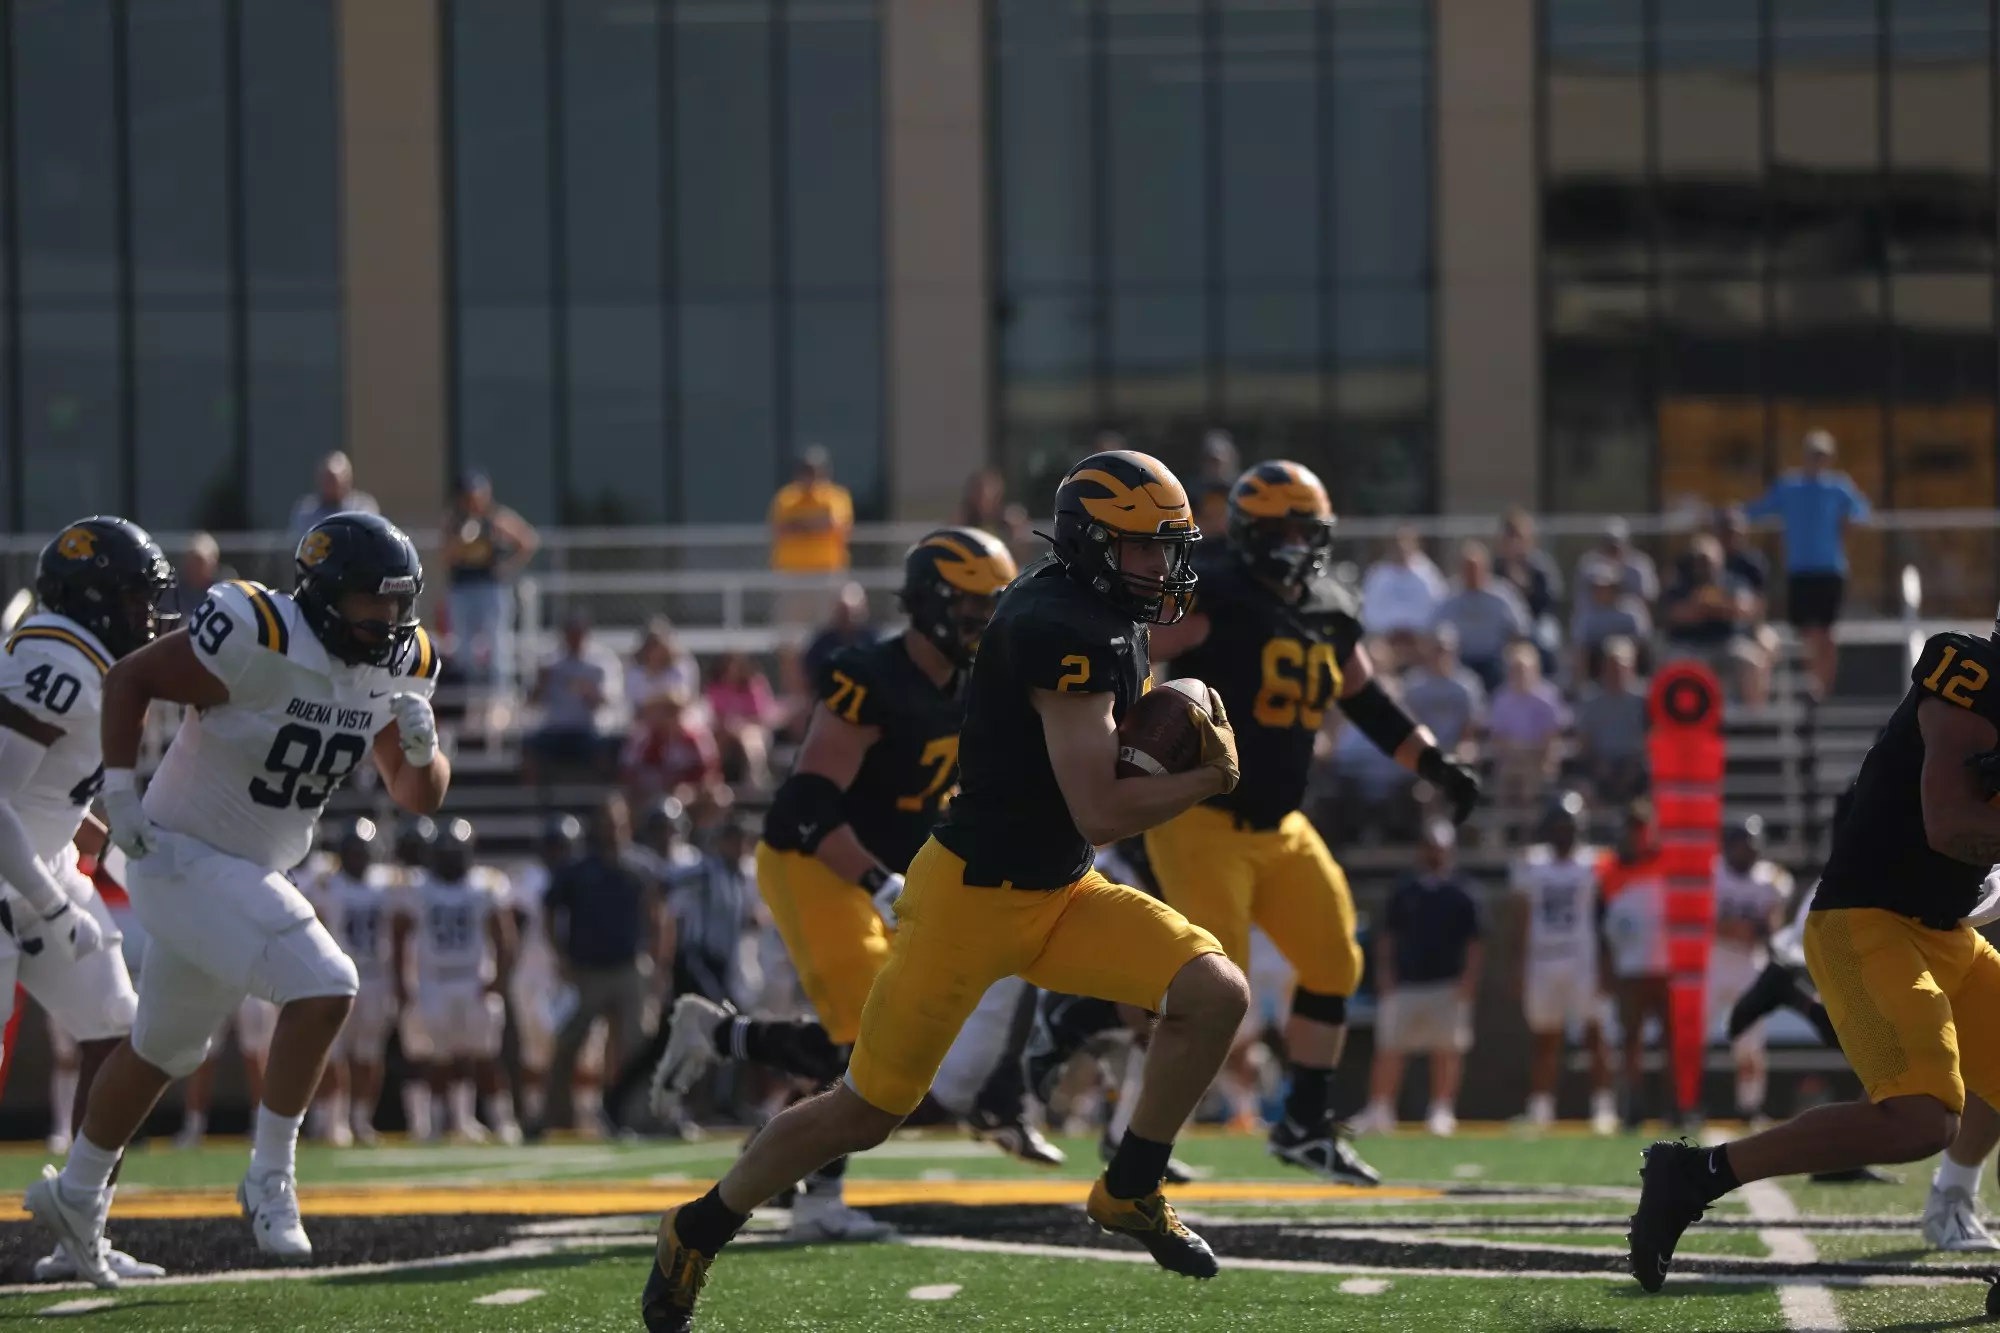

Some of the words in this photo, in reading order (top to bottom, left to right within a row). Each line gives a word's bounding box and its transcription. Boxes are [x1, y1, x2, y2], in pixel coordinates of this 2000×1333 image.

[189, 598, 233, 655] 99
[25, 664, 81, 714] 40
[825, 669, 868, 725] 71
[1057, 655, 1090, 693] 2
[1252, 637, 1344, 730] 60
[1923, 645, 1989, 709] 12
[286, 698, 332, 725] BUENA
[336, 708, 373, 730] VISTA
[249, 722, 366, 809] 99
[895, 733, 960, 813] 7
